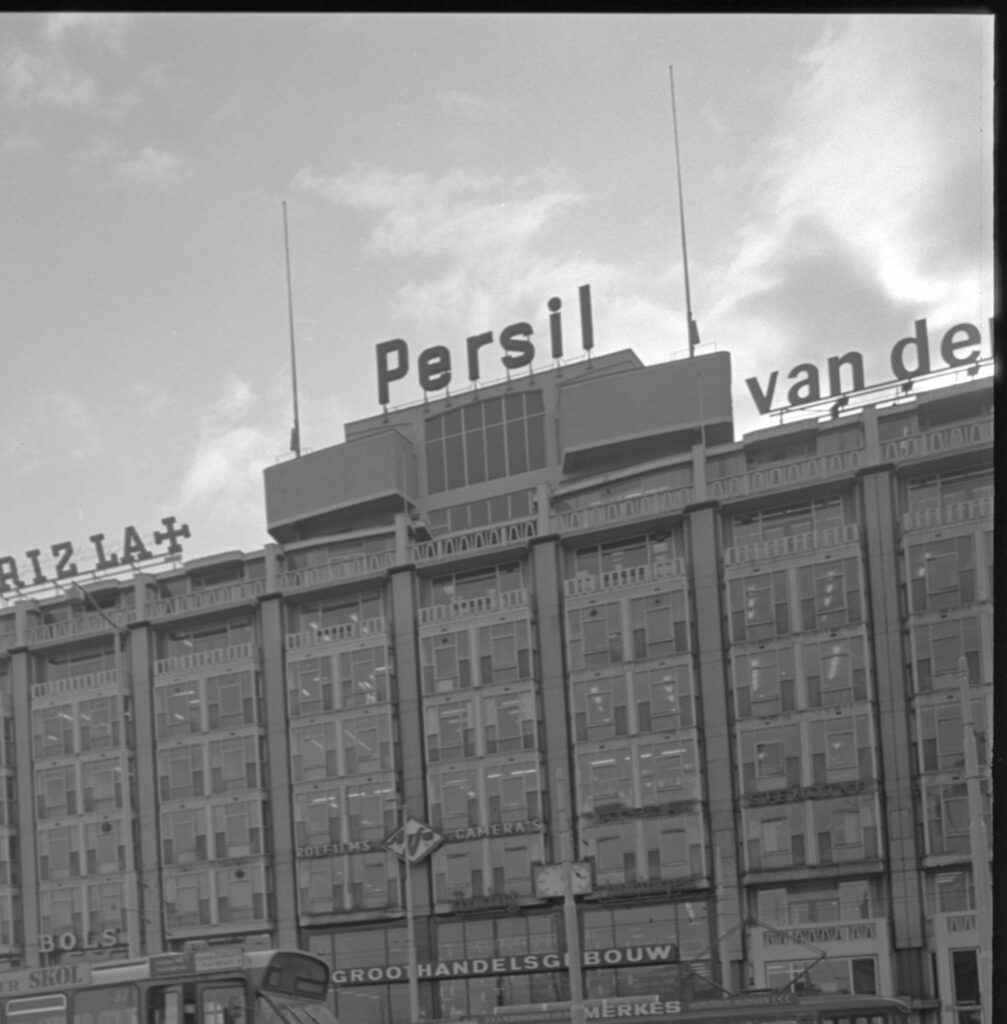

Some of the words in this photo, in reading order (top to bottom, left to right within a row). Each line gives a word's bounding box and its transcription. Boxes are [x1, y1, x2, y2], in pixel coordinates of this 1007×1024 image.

[376, 284, 595, 405] Persil
[745, 351, 865, 415] van
[890, 318, 995, 382] de
[455, 819, 542, 840] CAMERA'S
[296, 840, 371, 857] ROLFILMS
[39, 929, 117, 952] BOLS
[332, 945, 672, 984] GROOHANDELSGBOUW
[28, 965, 84, 989] SKOL
[584, 1000, 681, 1018] MERKES
